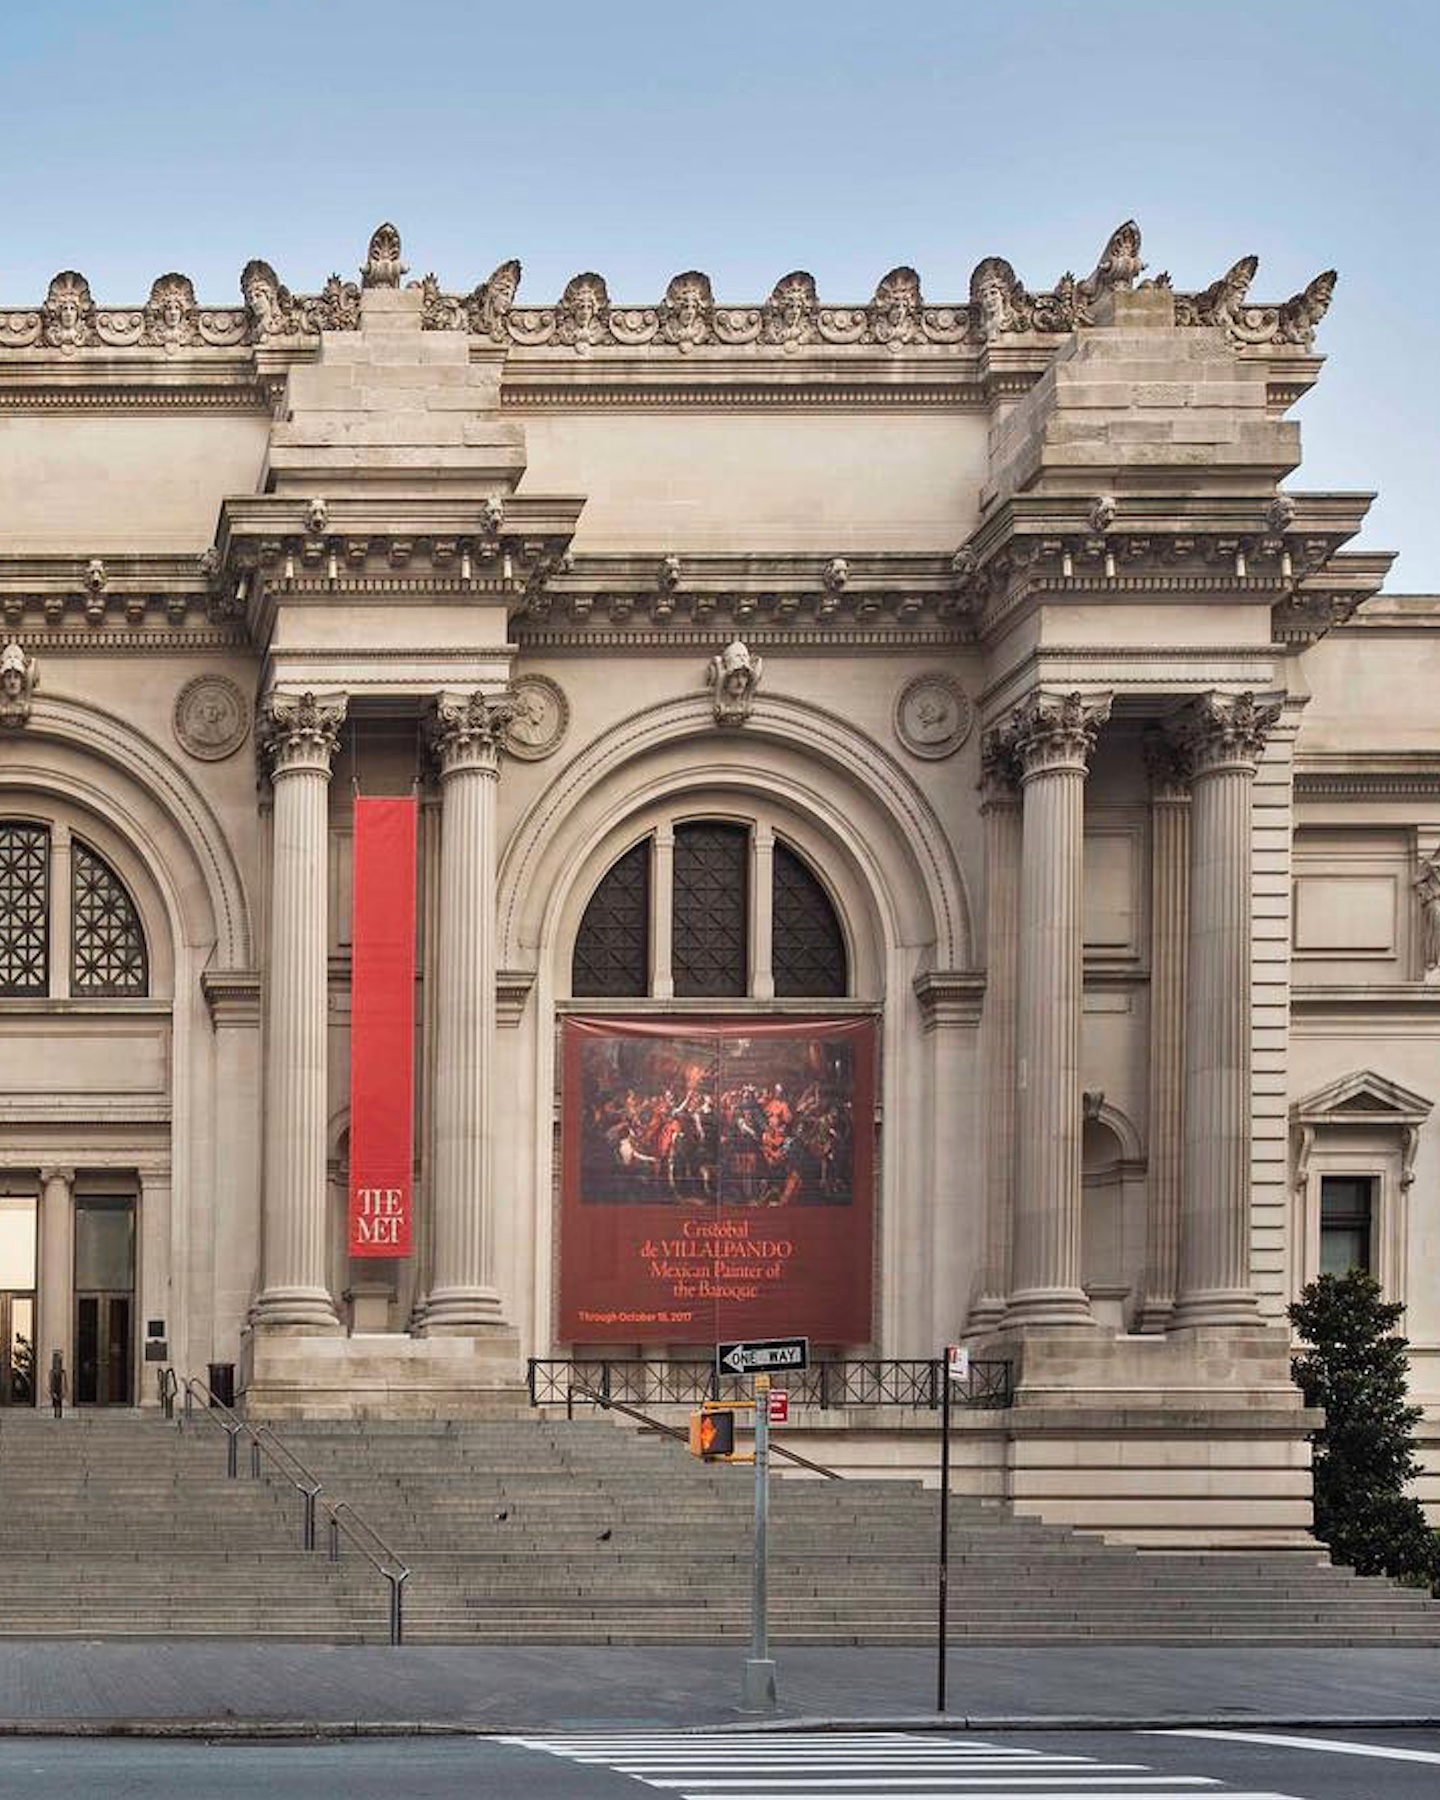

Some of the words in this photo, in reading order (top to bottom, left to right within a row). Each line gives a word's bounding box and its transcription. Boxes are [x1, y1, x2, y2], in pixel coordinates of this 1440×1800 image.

[357, 1188, 403, 1215] THE
[356, 1217, 404, 1243] MET
[641, 1239, 658, 1258] de
[661, 1240, 793, 1258] VILLALPANDO
[650, 1260, 710, 1278] Mexican
[714, 1260, 762, 1278] Painter
[766, 1260, 782, 1278] of
[673, 1280, 695, 1298] the
[698, 1280, 757, 1300] Baroque
[732, 1350, 757, 1366] ONE
[769, 1348, 795, 1363] WAY
